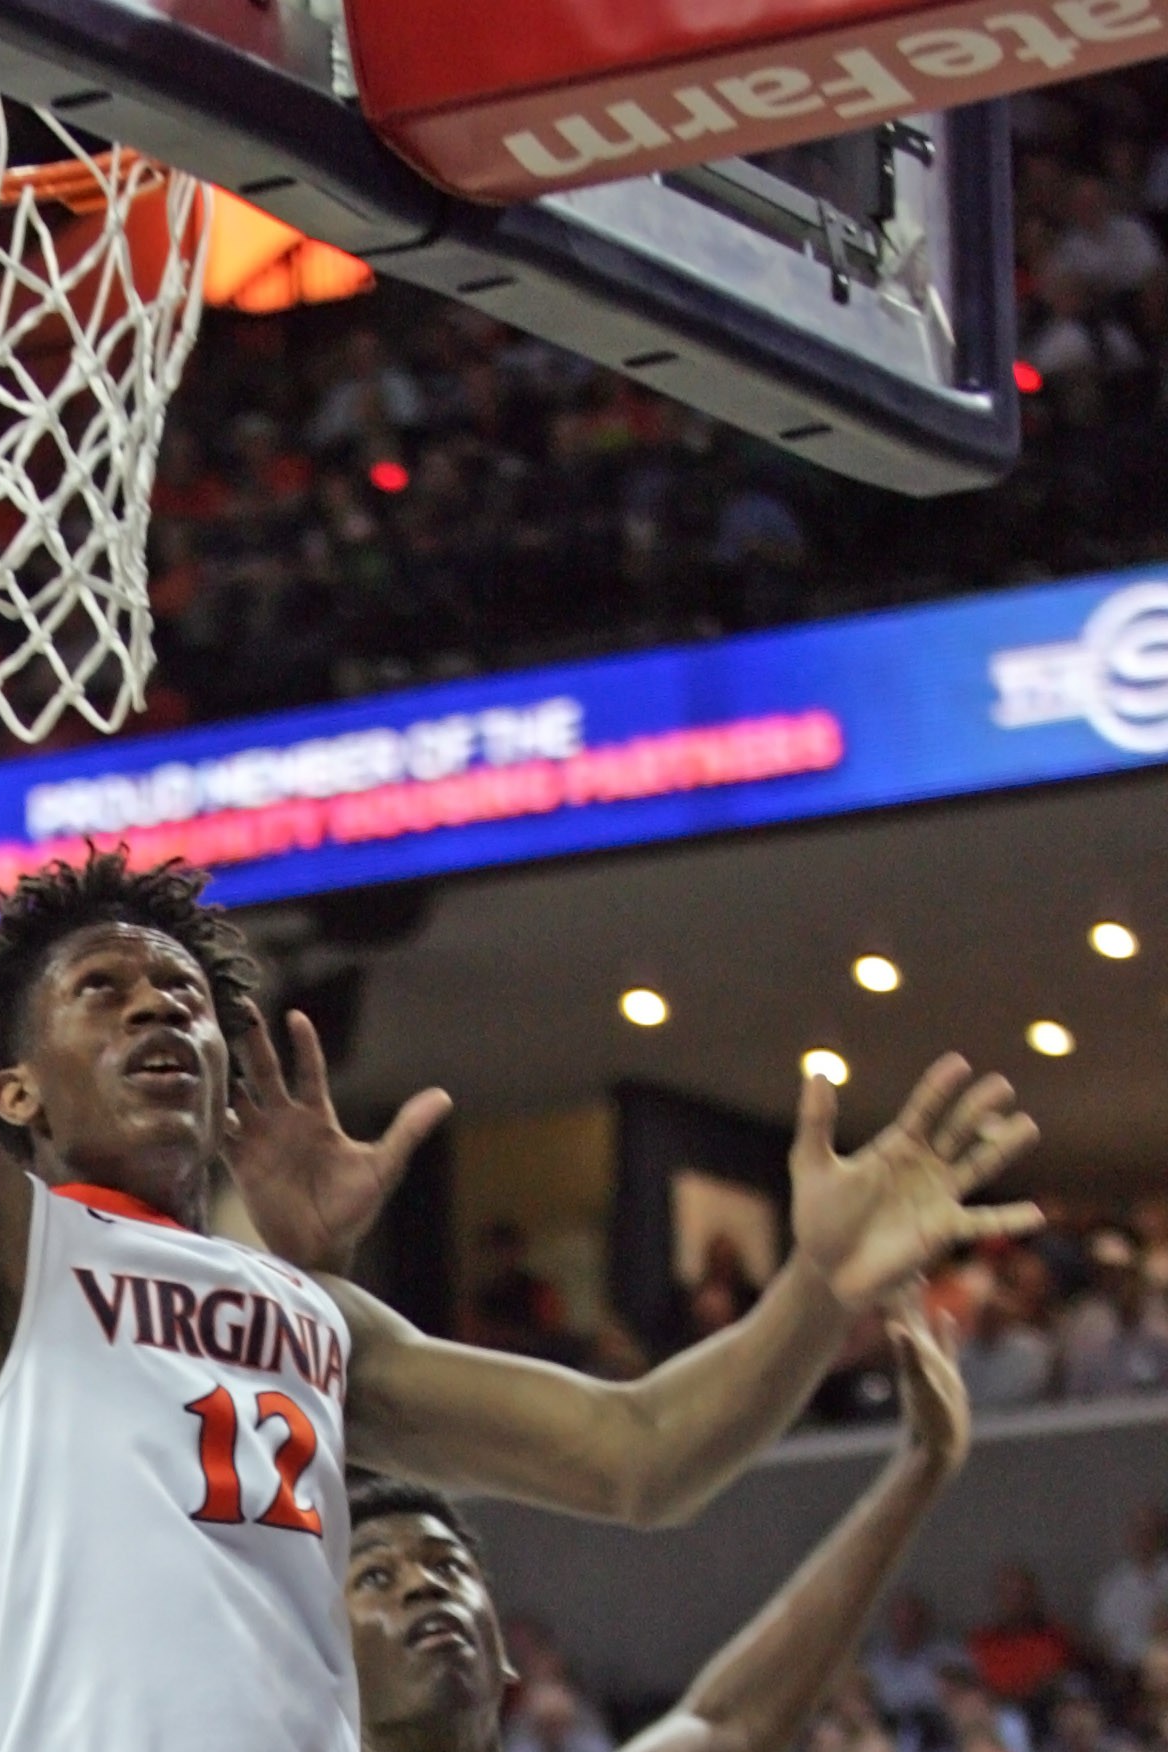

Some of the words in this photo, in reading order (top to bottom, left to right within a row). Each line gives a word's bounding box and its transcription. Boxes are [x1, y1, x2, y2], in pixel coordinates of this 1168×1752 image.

[502, 47, 915, 177] Farm
[71, 1265, 345, 1402] VIRGINIA
[184, 1384, 322, 1539] 12
